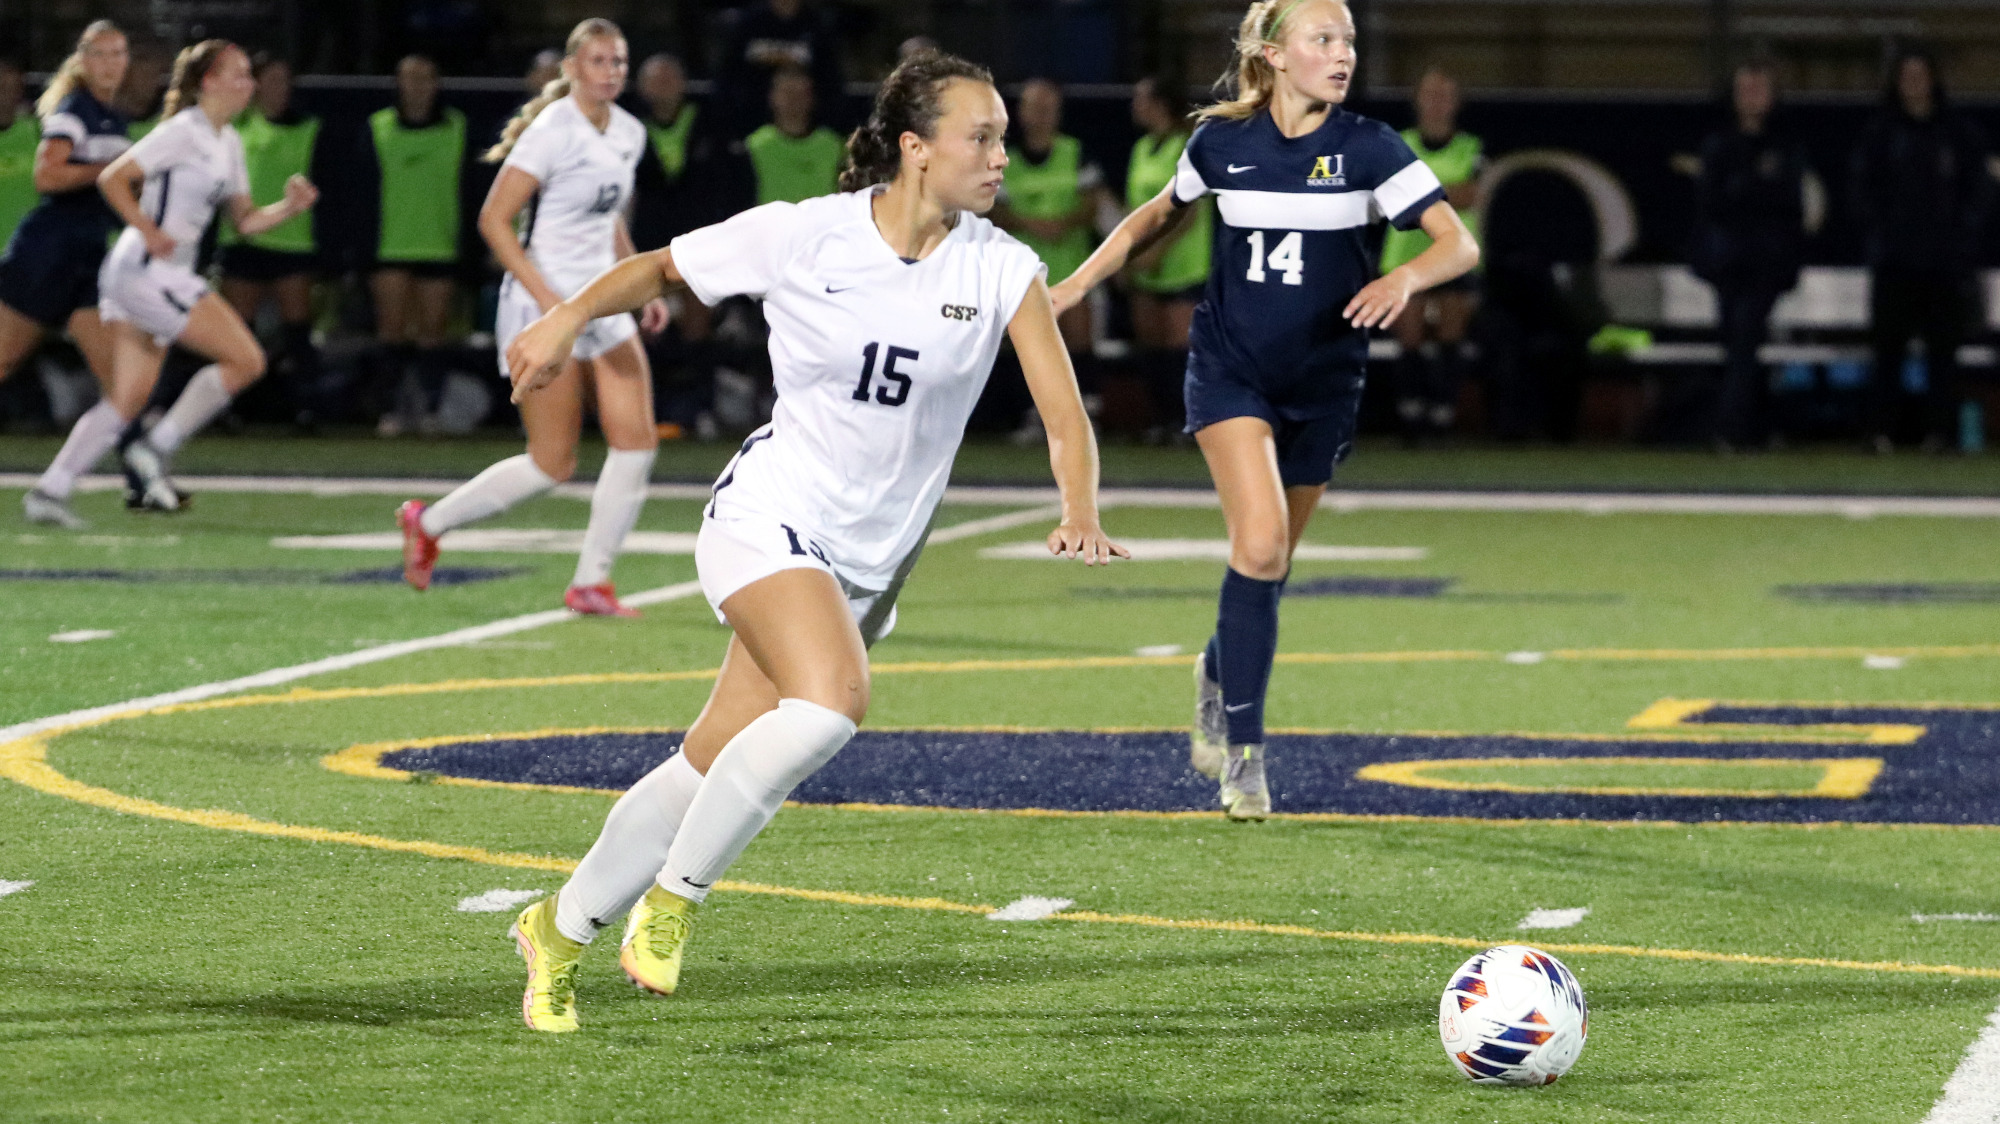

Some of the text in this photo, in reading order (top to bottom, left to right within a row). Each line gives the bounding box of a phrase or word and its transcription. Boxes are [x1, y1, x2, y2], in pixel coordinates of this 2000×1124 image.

[1307, 153, 1344, 178] AU
[1306, 177, 1346, 187] SOCCER
[1246, 230, 1304, 285] 14
[941, 303, 978, 322] CSP
[852, 341, 919, 407] 15
